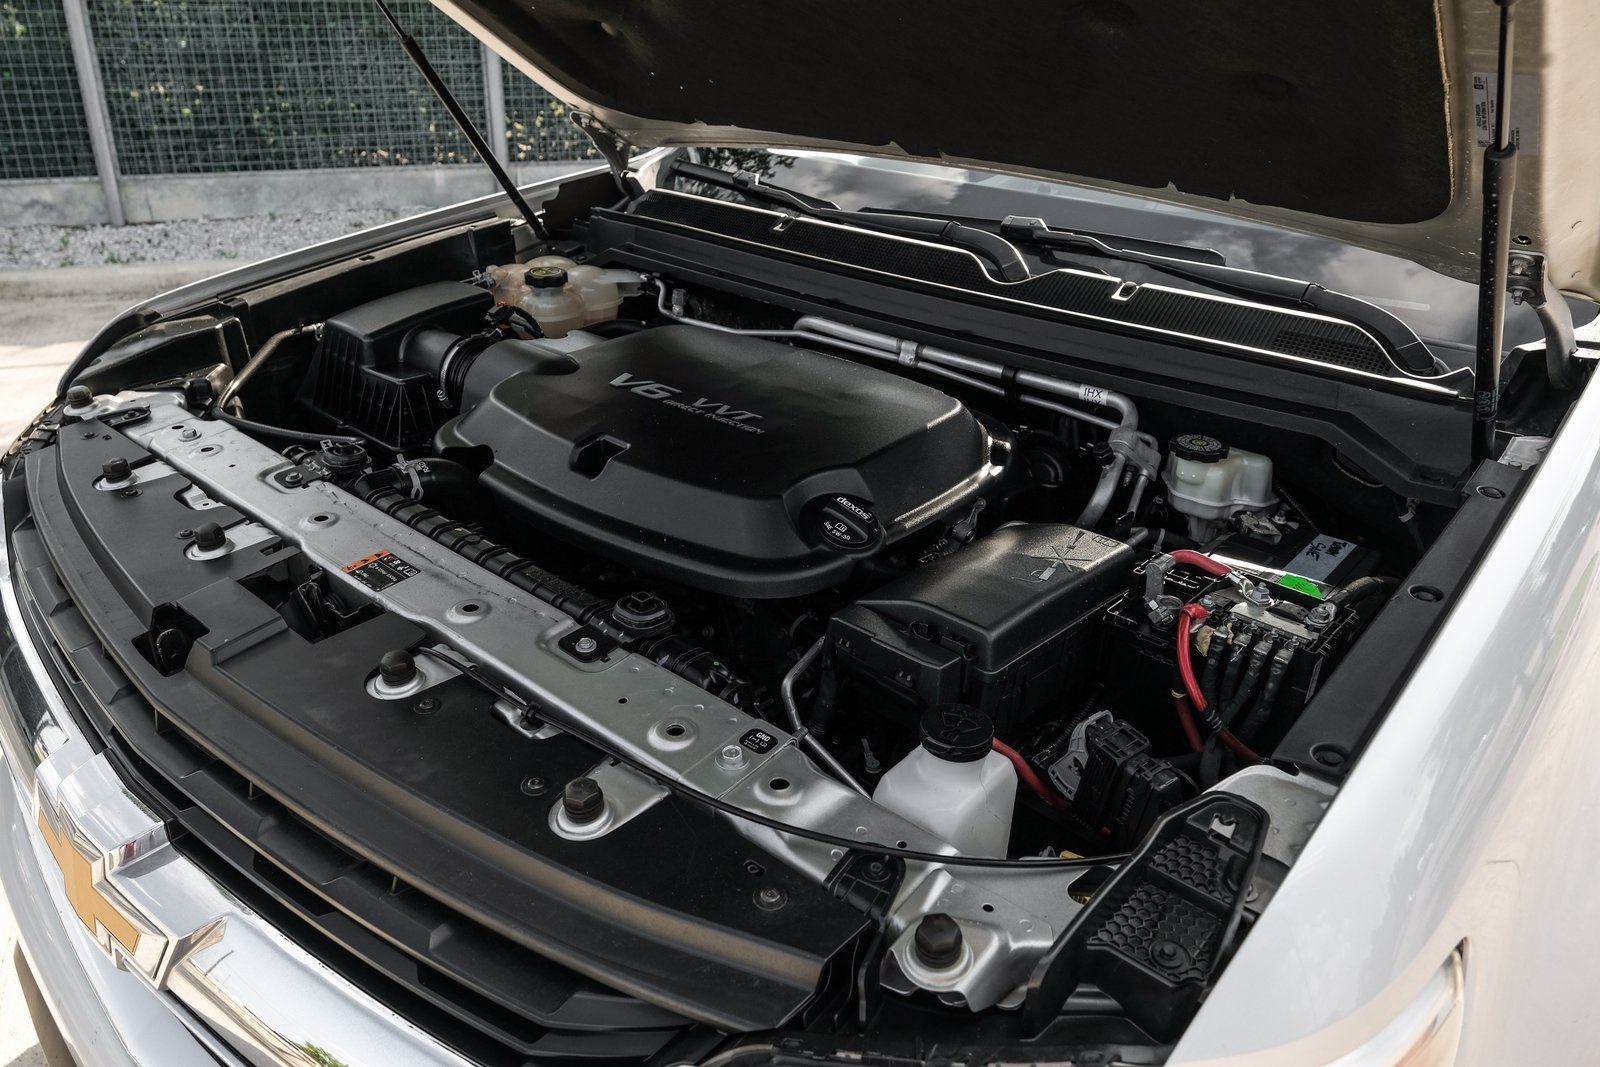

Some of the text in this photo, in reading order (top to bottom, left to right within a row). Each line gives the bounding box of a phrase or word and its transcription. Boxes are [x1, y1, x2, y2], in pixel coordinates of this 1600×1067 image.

[609, 372, 764, 420] V6 VVT
[662, 399, 765, 435] DIRECT INJECTION
[836, 496, 870, 520] dexos
[755, 731, 771, 742] GND
